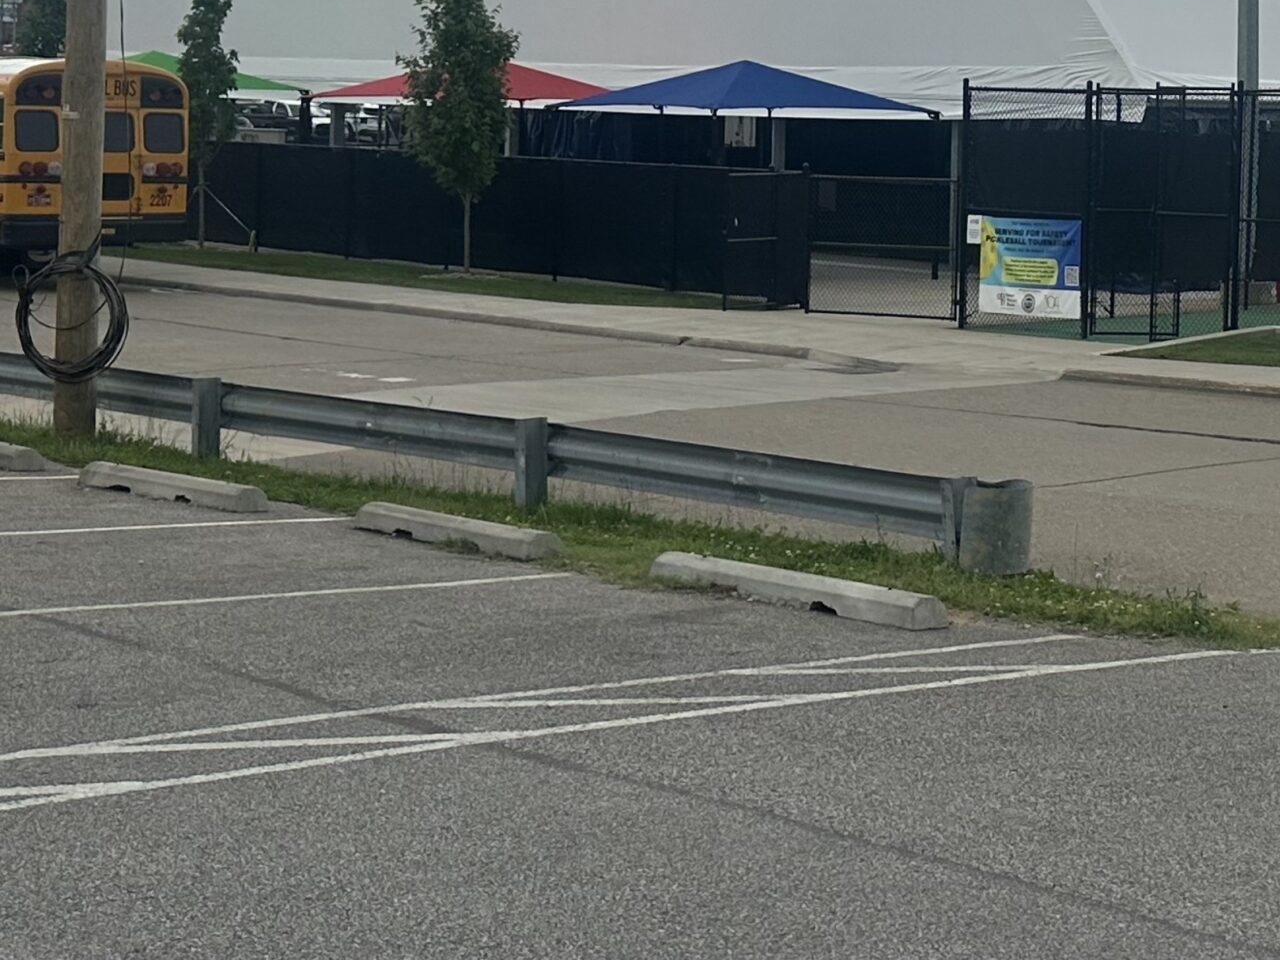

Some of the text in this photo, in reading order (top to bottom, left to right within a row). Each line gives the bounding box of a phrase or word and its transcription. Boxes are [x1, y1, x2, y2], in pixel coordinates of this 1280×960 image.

[114, 80, 136, 96] BUS
[150, 195, 172, 207] 2207
[1026, 229, 1040, 237] FOR
